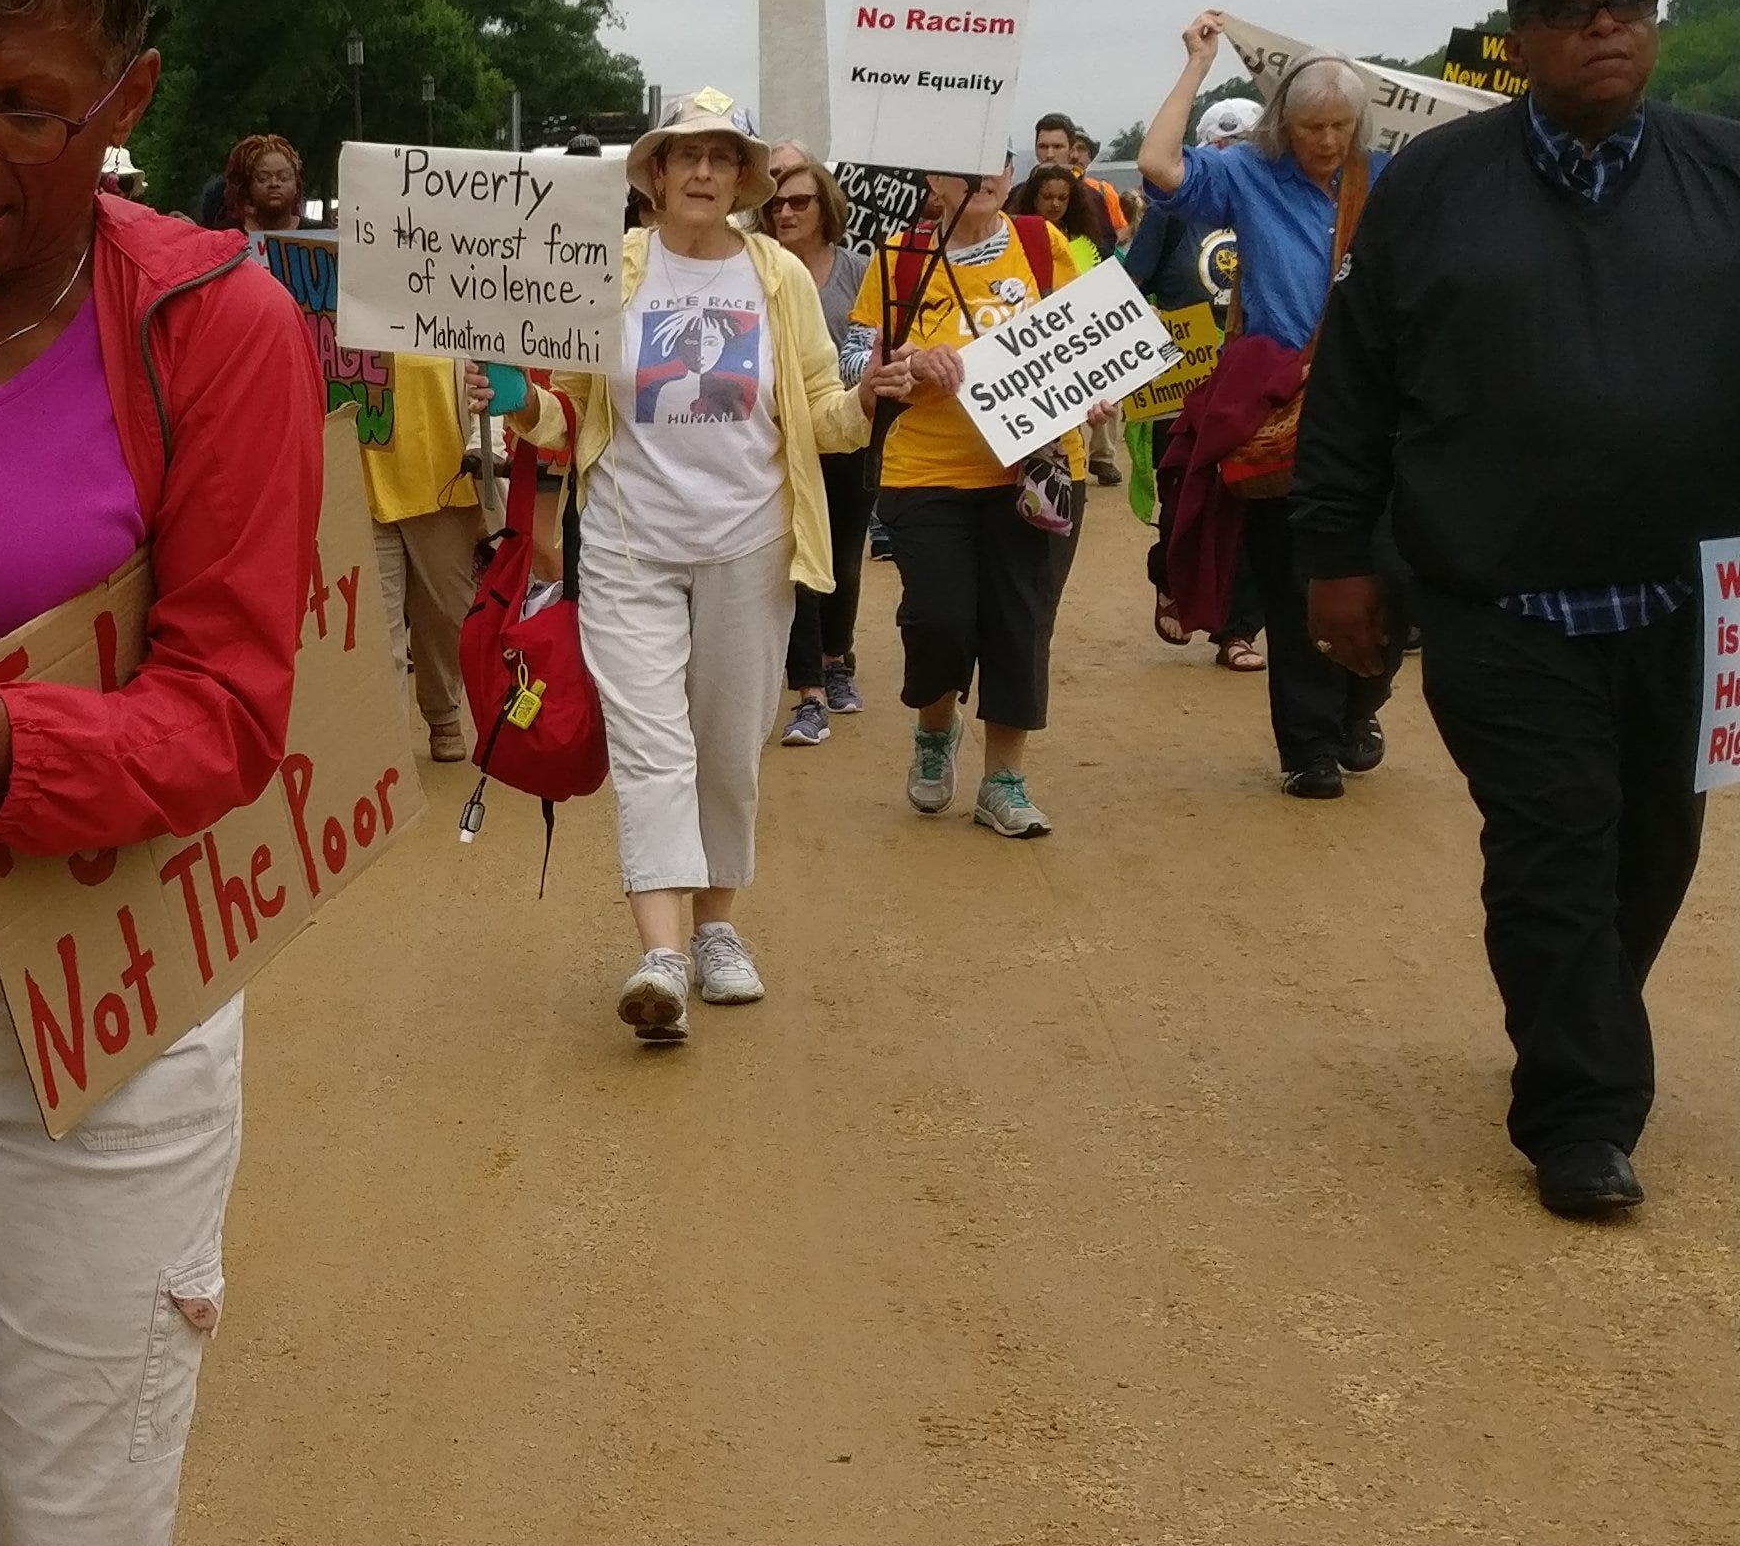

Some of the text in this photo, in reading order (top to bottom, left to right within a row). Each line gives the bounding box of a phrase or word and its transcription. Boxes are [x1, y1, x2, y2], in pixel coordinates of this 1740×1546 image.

[856, 6, 1015, 34] No Racism
[851, 65, 1004, 96] Know Equality
[1442, 62, 1487, 89] New
[355, 205, 609, 267] is the worst form
[408, 257, 436, 295] of
[708, 296, 756, 311] RACE
[413, 311, 506, 355] Mahatma
[520, 318, 601, 364] Gandhi
[993, 299, 1077, 357] Voter
[970, 297, 1144, 413] Suppression
[1000, 413, 1036, 441] is
[1030, 337, 1156, 421] Violence
[667, 412, 734, 425] HUMAN
[1717, 616, 1740, 656] is
[25, 752, 400, 1111] Not The Poor
